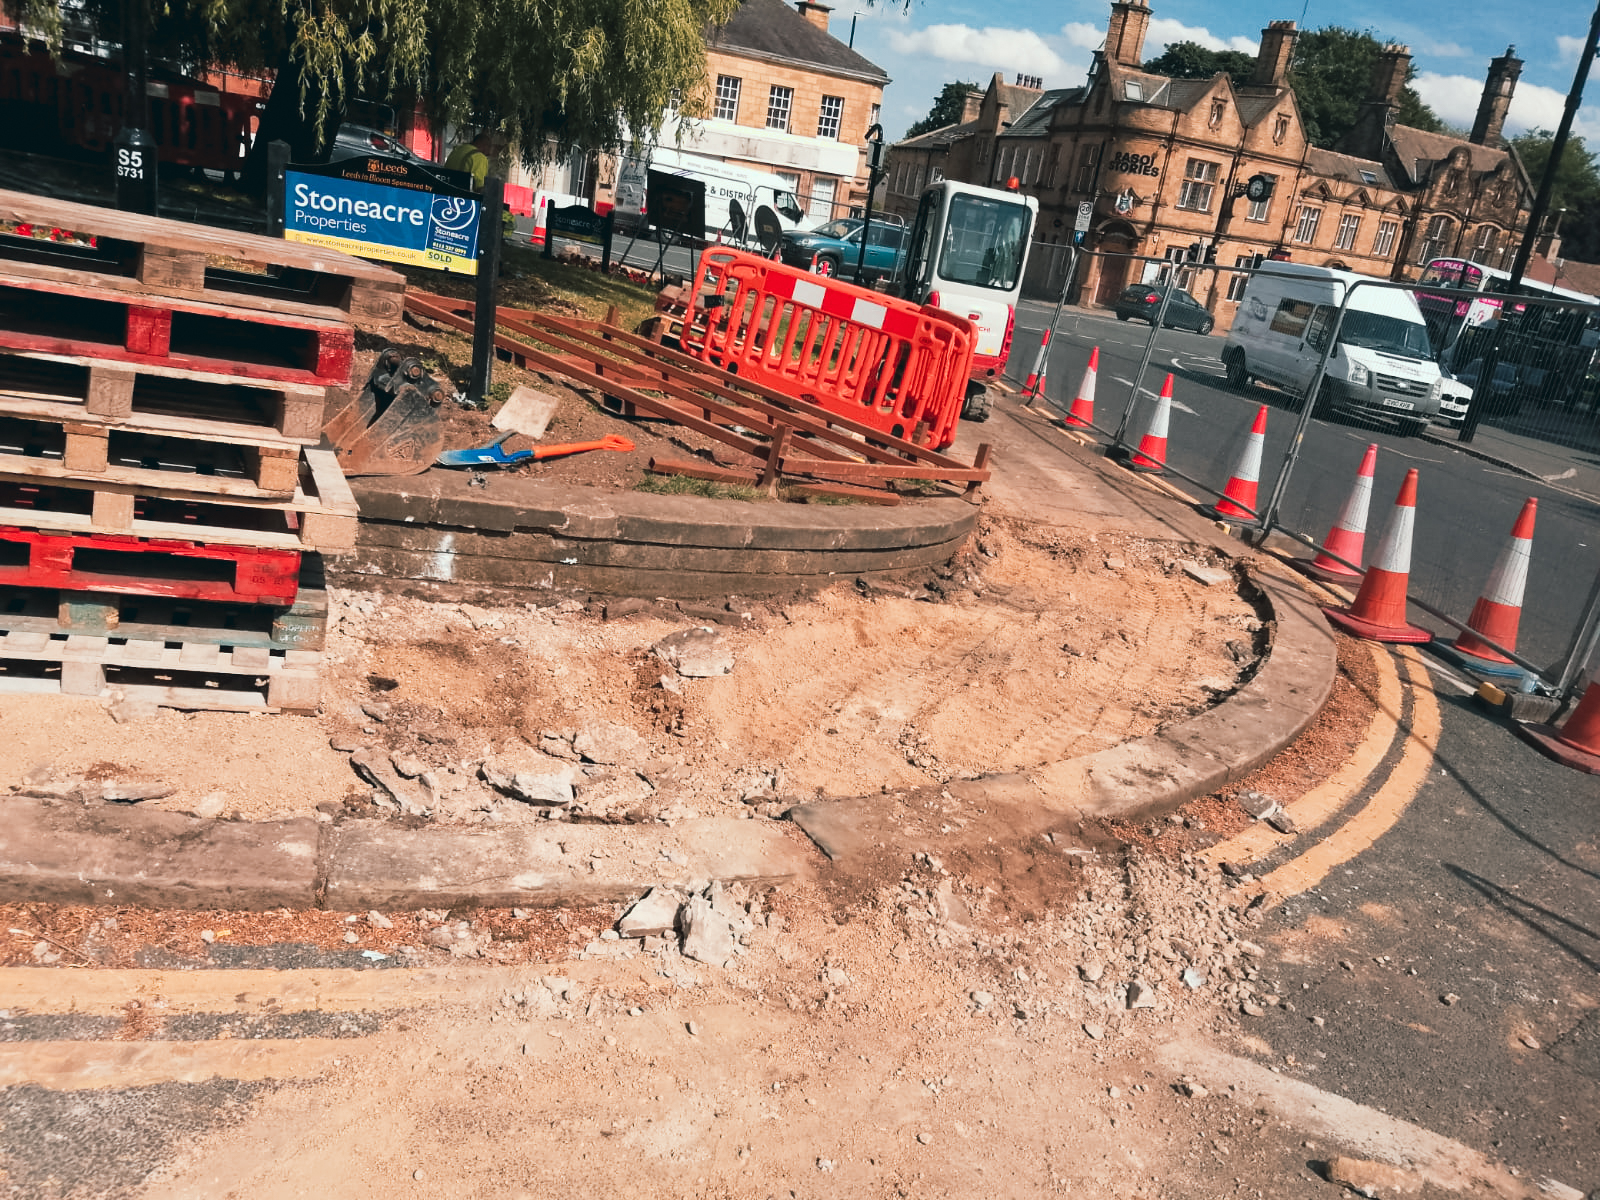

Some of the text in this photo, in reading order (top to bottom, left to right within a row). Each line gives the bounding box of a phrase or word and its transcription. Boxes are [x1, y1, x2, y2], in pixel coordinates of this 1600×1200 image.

[118, 148, 143, 168] S5
[1114, 151, 1158, 168] RASOI
[117, 165, 144, 180] S731
[380, 161, 408, 175] Leeds
[1109, 160, 1160, 177] STORIES
[369, 173, 391, 185] Bloom
[710, 185, 717, 195] &
[294, 183, 424, 226] Stoneacre
[295, 210, 367, 234] Properties
[428, 251, 452, 263] SOLD
